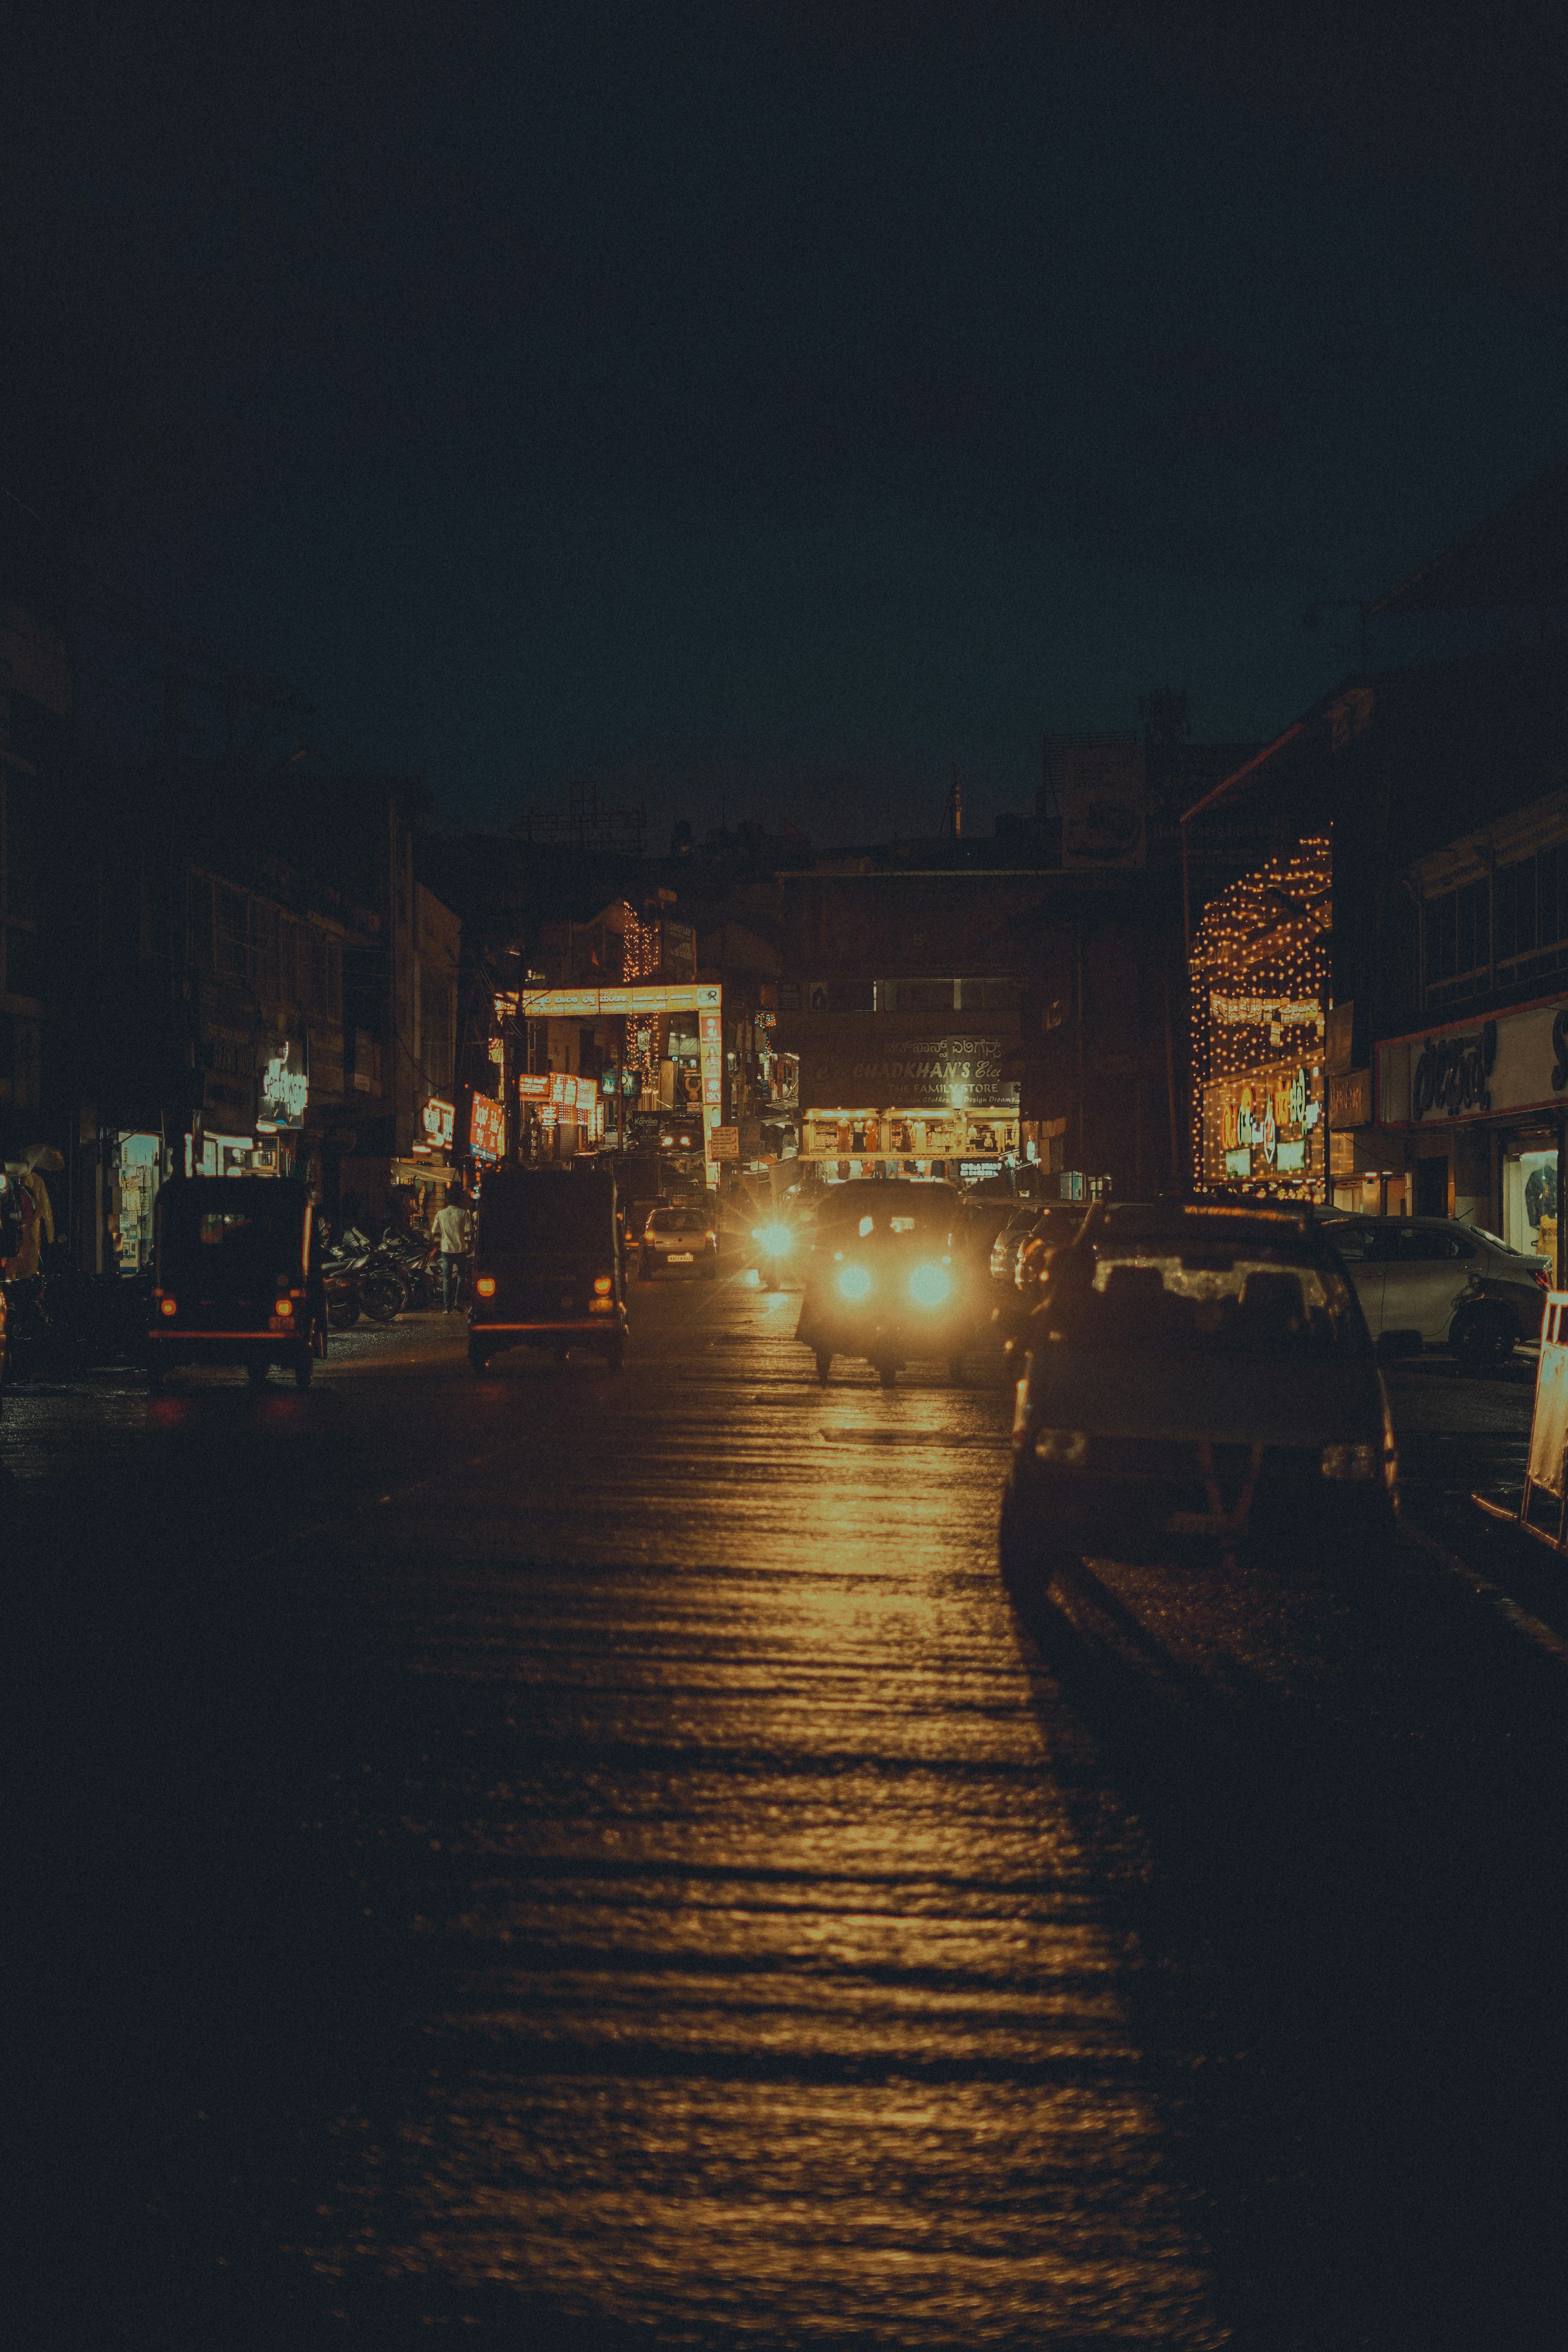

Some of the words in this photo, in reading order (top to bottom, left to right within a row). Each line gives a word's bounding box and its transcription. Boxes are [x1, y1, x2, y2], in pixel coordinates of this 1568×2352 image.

[853, 1061, 971, 1078] CHADKHAN'S
[914, 1083, 958, 1093] FAMILY
[960, 1083, 998, 1093] STORE
